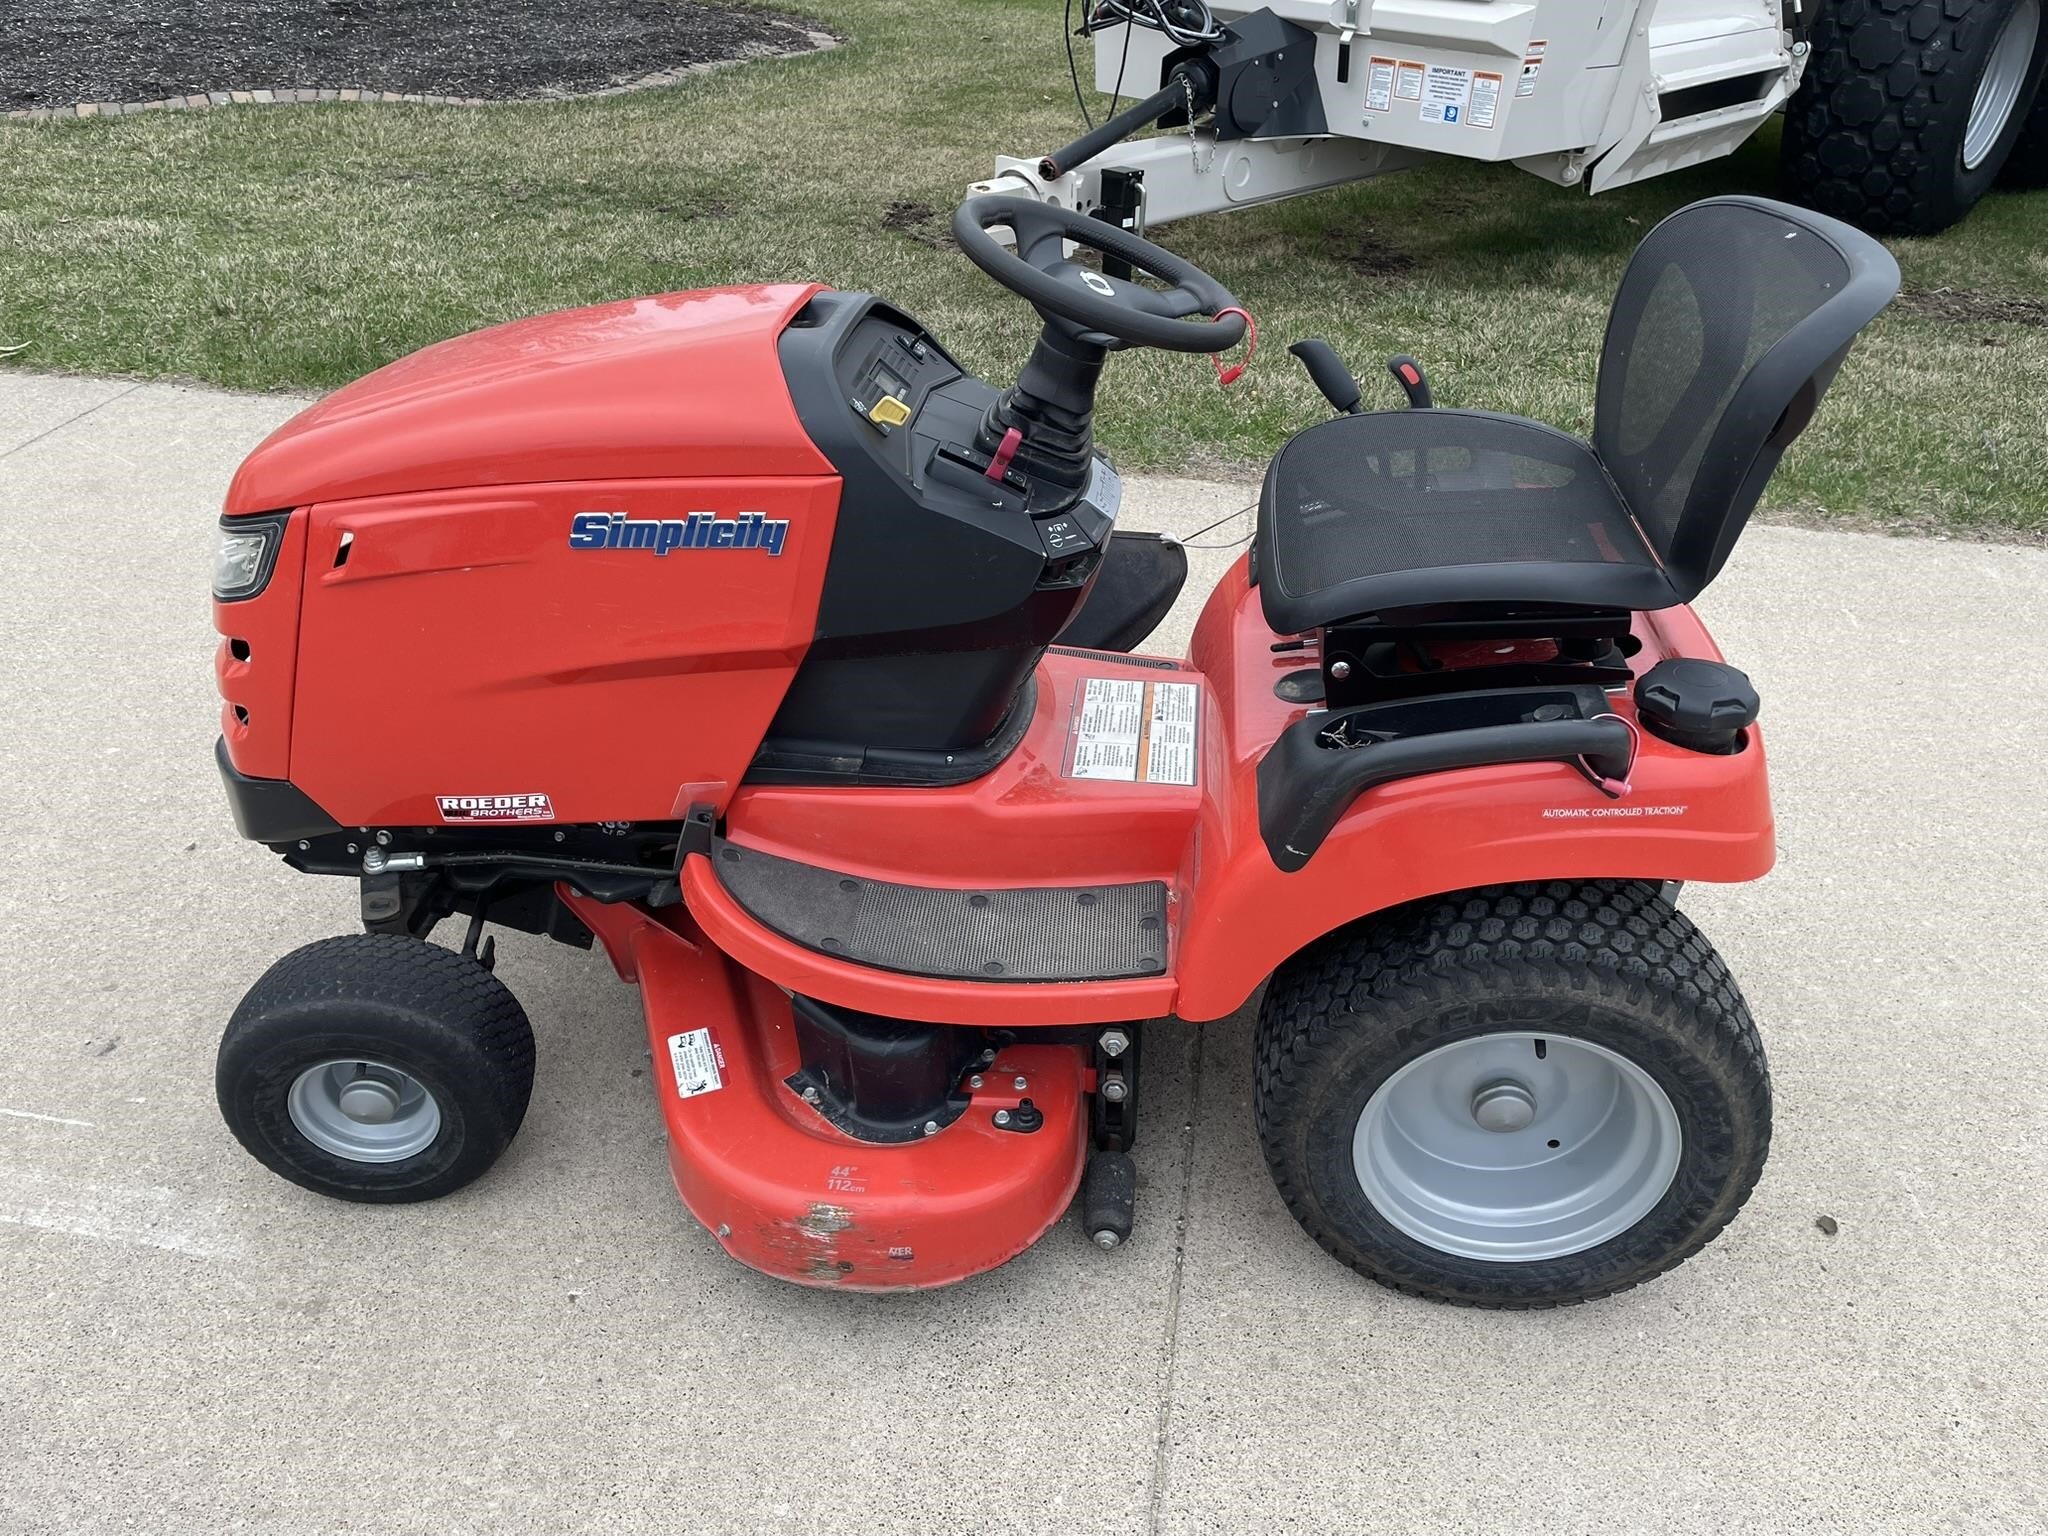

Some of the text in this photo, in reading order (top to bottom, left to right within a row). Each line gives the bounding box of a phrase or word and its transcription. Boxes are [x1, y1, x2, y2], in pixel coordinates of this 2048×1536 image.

[1431, 67, 1467, 77] IMPORTANT
[568, 511, 791, 556] Simplicity
[441, 795, 547, 810] ROEDER
[470, 807, 542, 817] BROTHERS
[1542, 808, 1590, 818] AUTOMATIC
[1591, 807, 1642, 817] CONTROLLED
[714, 1047, 726, 1069] DANGER
